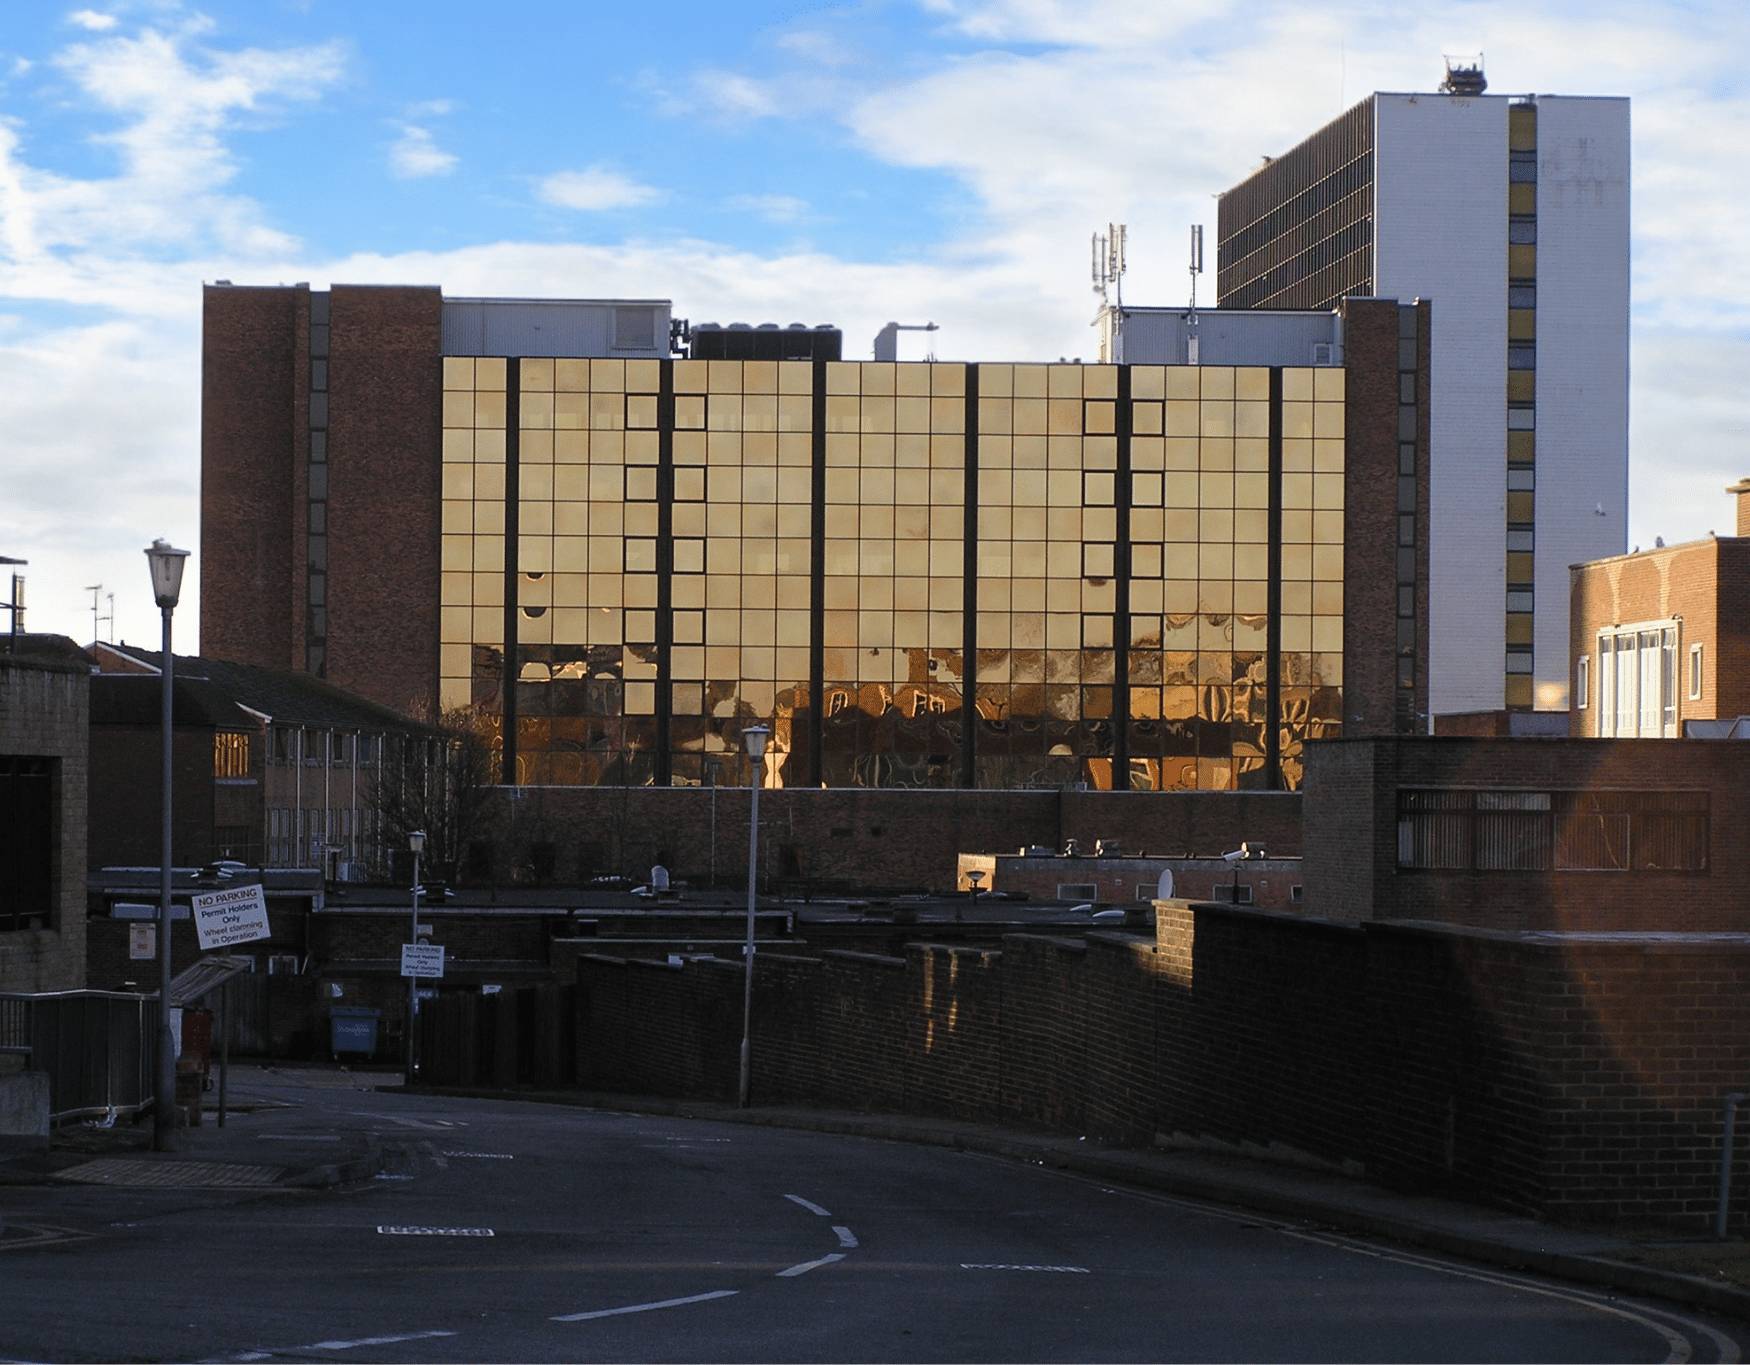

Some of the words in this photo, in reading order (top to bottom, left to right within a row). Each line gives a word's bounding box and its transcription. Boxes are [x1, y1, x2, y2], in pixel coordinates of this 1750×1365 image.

[198, 896, 213, 906] NO
[215, 888, 257, 902] PARKING
[201, 907, 226, 918] Permit
[228, 903, 258, 913] Holders
[222, 915, 240, 924] Only
[203, 925, 228, 936] Wheel
[220, 931, 258, 943] Operation
